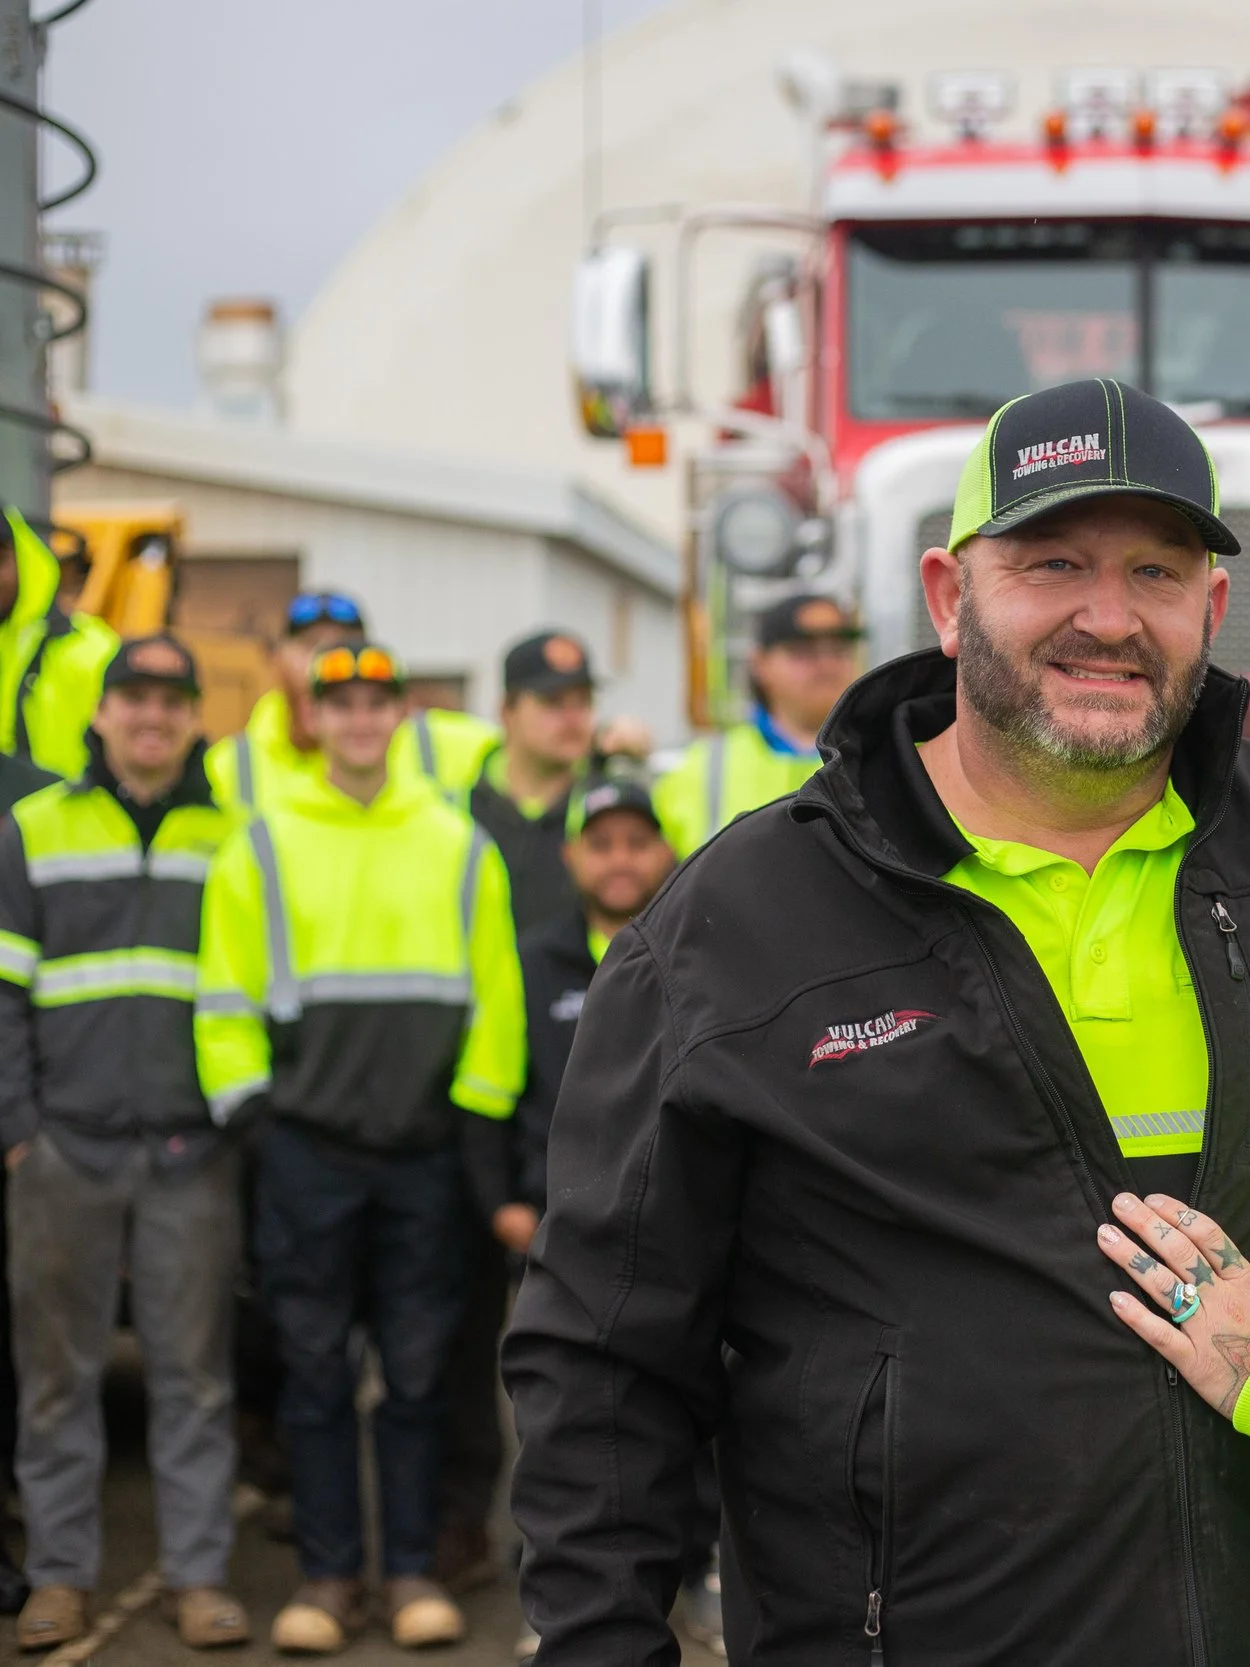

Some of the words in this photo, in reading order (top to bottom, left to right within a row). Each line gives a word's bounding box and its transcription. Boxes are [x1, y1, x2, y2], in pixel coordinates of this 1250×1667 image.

[1012, 460, 1048, 480] TOWING
[1048, 457, 1057, 468] &
[1056, 448, 1106, 466] RECOVERY
[1017, 433, 1099, 466] VULCAN
[812, 1039, 855, 1060] TOWING
[857, 1039, 868, 1050] &
[869, 1018, 918, 1048] RECOVERY
[828, 1011, 897, 1040] VULCAN
